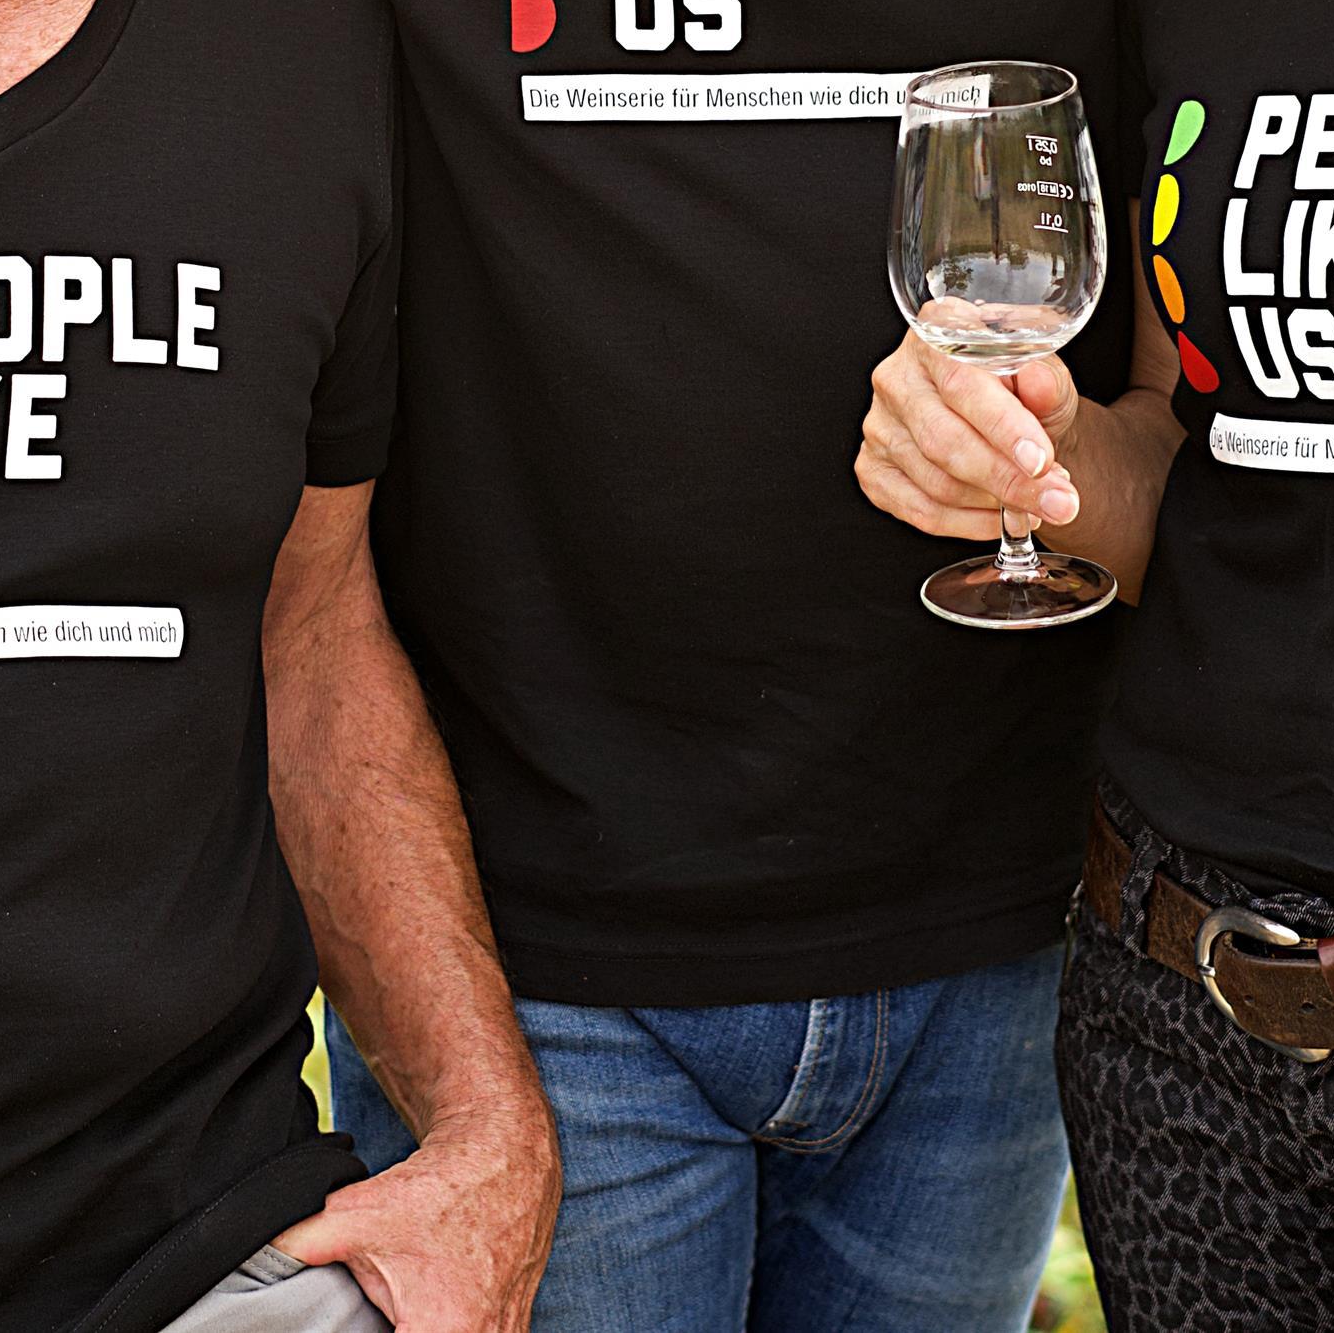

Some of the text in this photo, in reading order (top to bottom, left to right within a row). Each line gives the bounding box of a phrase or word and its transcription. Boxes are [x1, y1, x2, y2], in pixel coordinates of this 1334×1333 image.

[529, 88, 560, 108] Die
[566, 87, 665, 108] Weinserie
[671, 87, 700, 108] für
[705, 86, 803, 108] Menschen
[809, 85, 842, 106] wie
[848, 85, 889, 105] dich
[1224, 430, 1289, 457] Weinserie
[1294, 436, 1319, 459] für
[13, 620, 48, 643] wie
[55, 620, 93, 643] dich
[98, 621, 133, 643] und
[138, 620, 178, 644] mich
